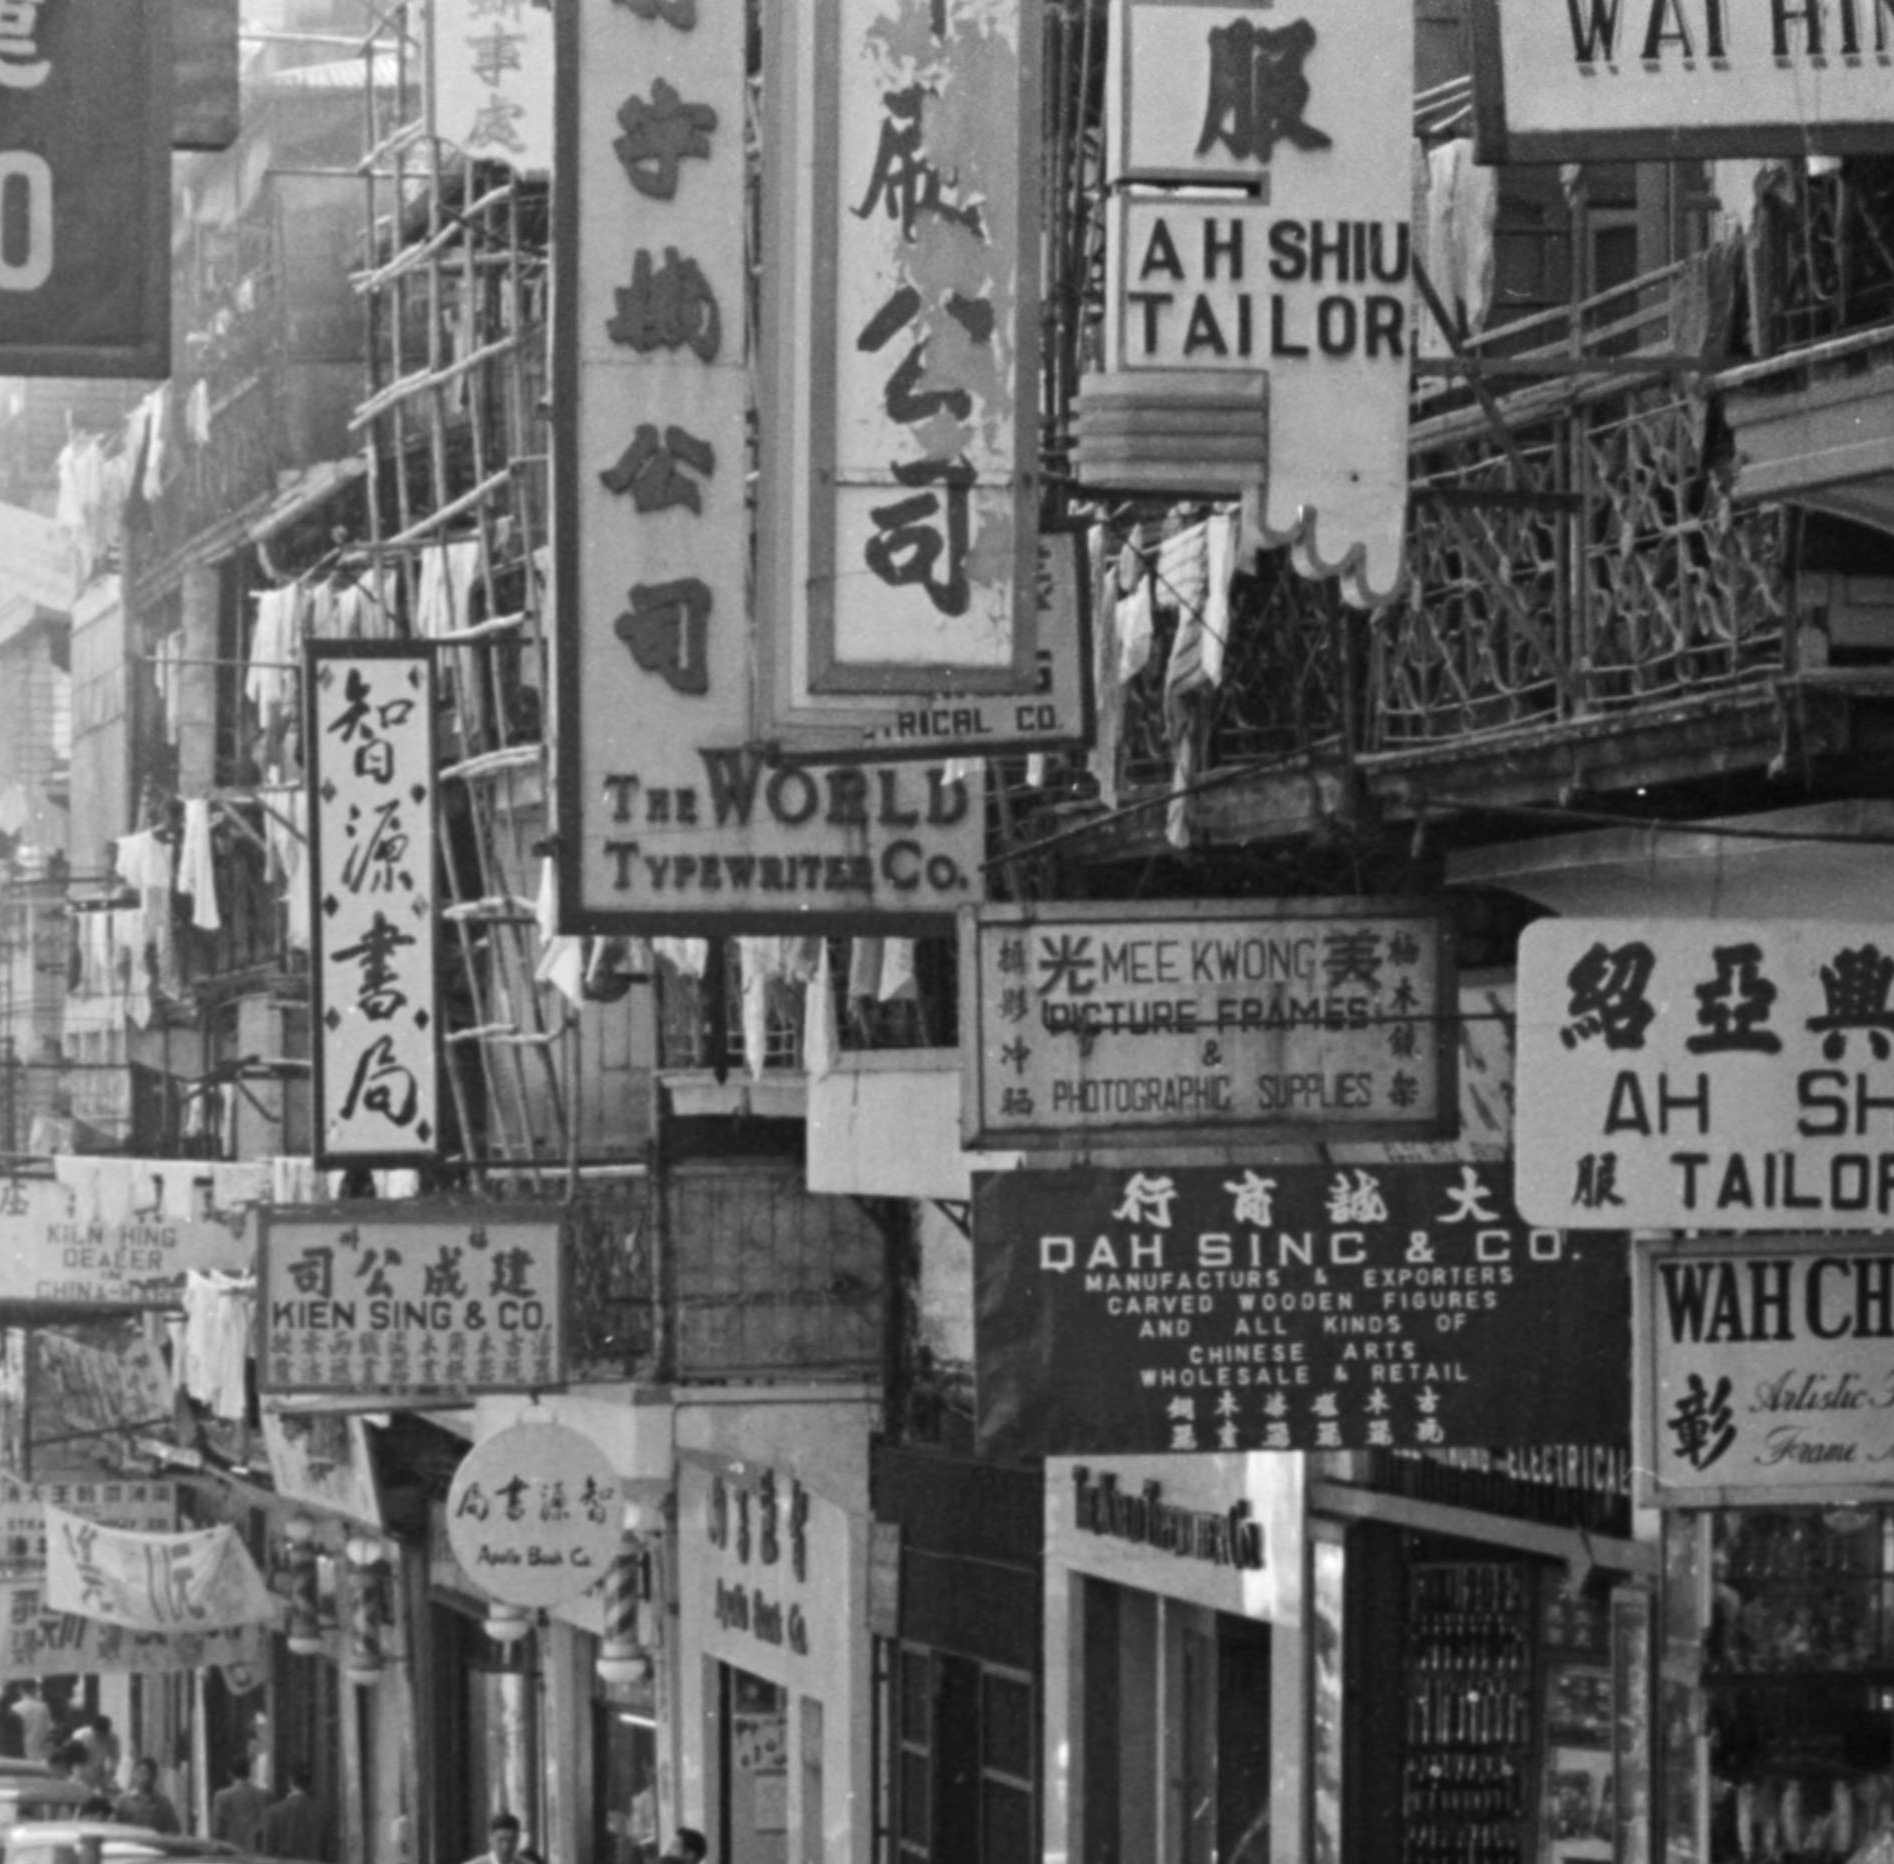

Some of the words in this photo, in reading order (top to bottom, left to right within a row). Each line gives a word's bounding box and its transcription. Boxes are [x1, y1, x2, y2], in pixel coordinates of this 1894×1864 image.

[1140, 218, 1246, 284] AH
[1267, 217, 1411, 285] SHIU
[1126, 292, 1407, 358] TAILOR
[709, 752, 971, 826] WORLD
[603, 841, 874, 893] TYPEWRITER
[326, 667, 421, 1128] 智源書局
[1102, 941, 1180, 985] MEE
[1191, 938, 1316, 983] KWONG
[1216, 997, 1370, 1033] FRAMES
[1052, 1073, 1231, 1113] PHOTOGRAPHIC
[1258, 1072, 1372, 1110] SUPPLIES
[1602, 1070, 1711, 1137] AH
[1404, 1230, 1435, 1265] &
[1475, 1228, 1582, 1263] CO.
[1362, 1266, 1515, 1289] EXPORTERS
[272, 1300, 356, 1329] KIEN
[369, 1300, 453, 1331] SING
[463, 1300, 487, 1330] &
[1106, 1293, 1215, 1316] CARVED
[1238, 1291, 1354, 1312] WOODEN
[1382, 1290, 1499, 1311] FIGURES
[1657, 1259, 1796, 1343] WAH
[1138, 1317, 1192, 1339] AND
[1233, 1316, 1289, 1336] ALL
[1322, 1314, 1403, 1335] KINDS
[1435, 1312, 1467, 1333] OF
[1188, 1342, 1306, 1365] CHINESE
[1341, 1340, 1417, 1362] ARTS
[1138, 1364, 1311, 1388] WHOLESALE
[1370, 1362, 1471, 1384] RETAIL
[1748, 1368, 1868, 1412] Artistic
[1753, 1425, 1858, 1466] Frame
